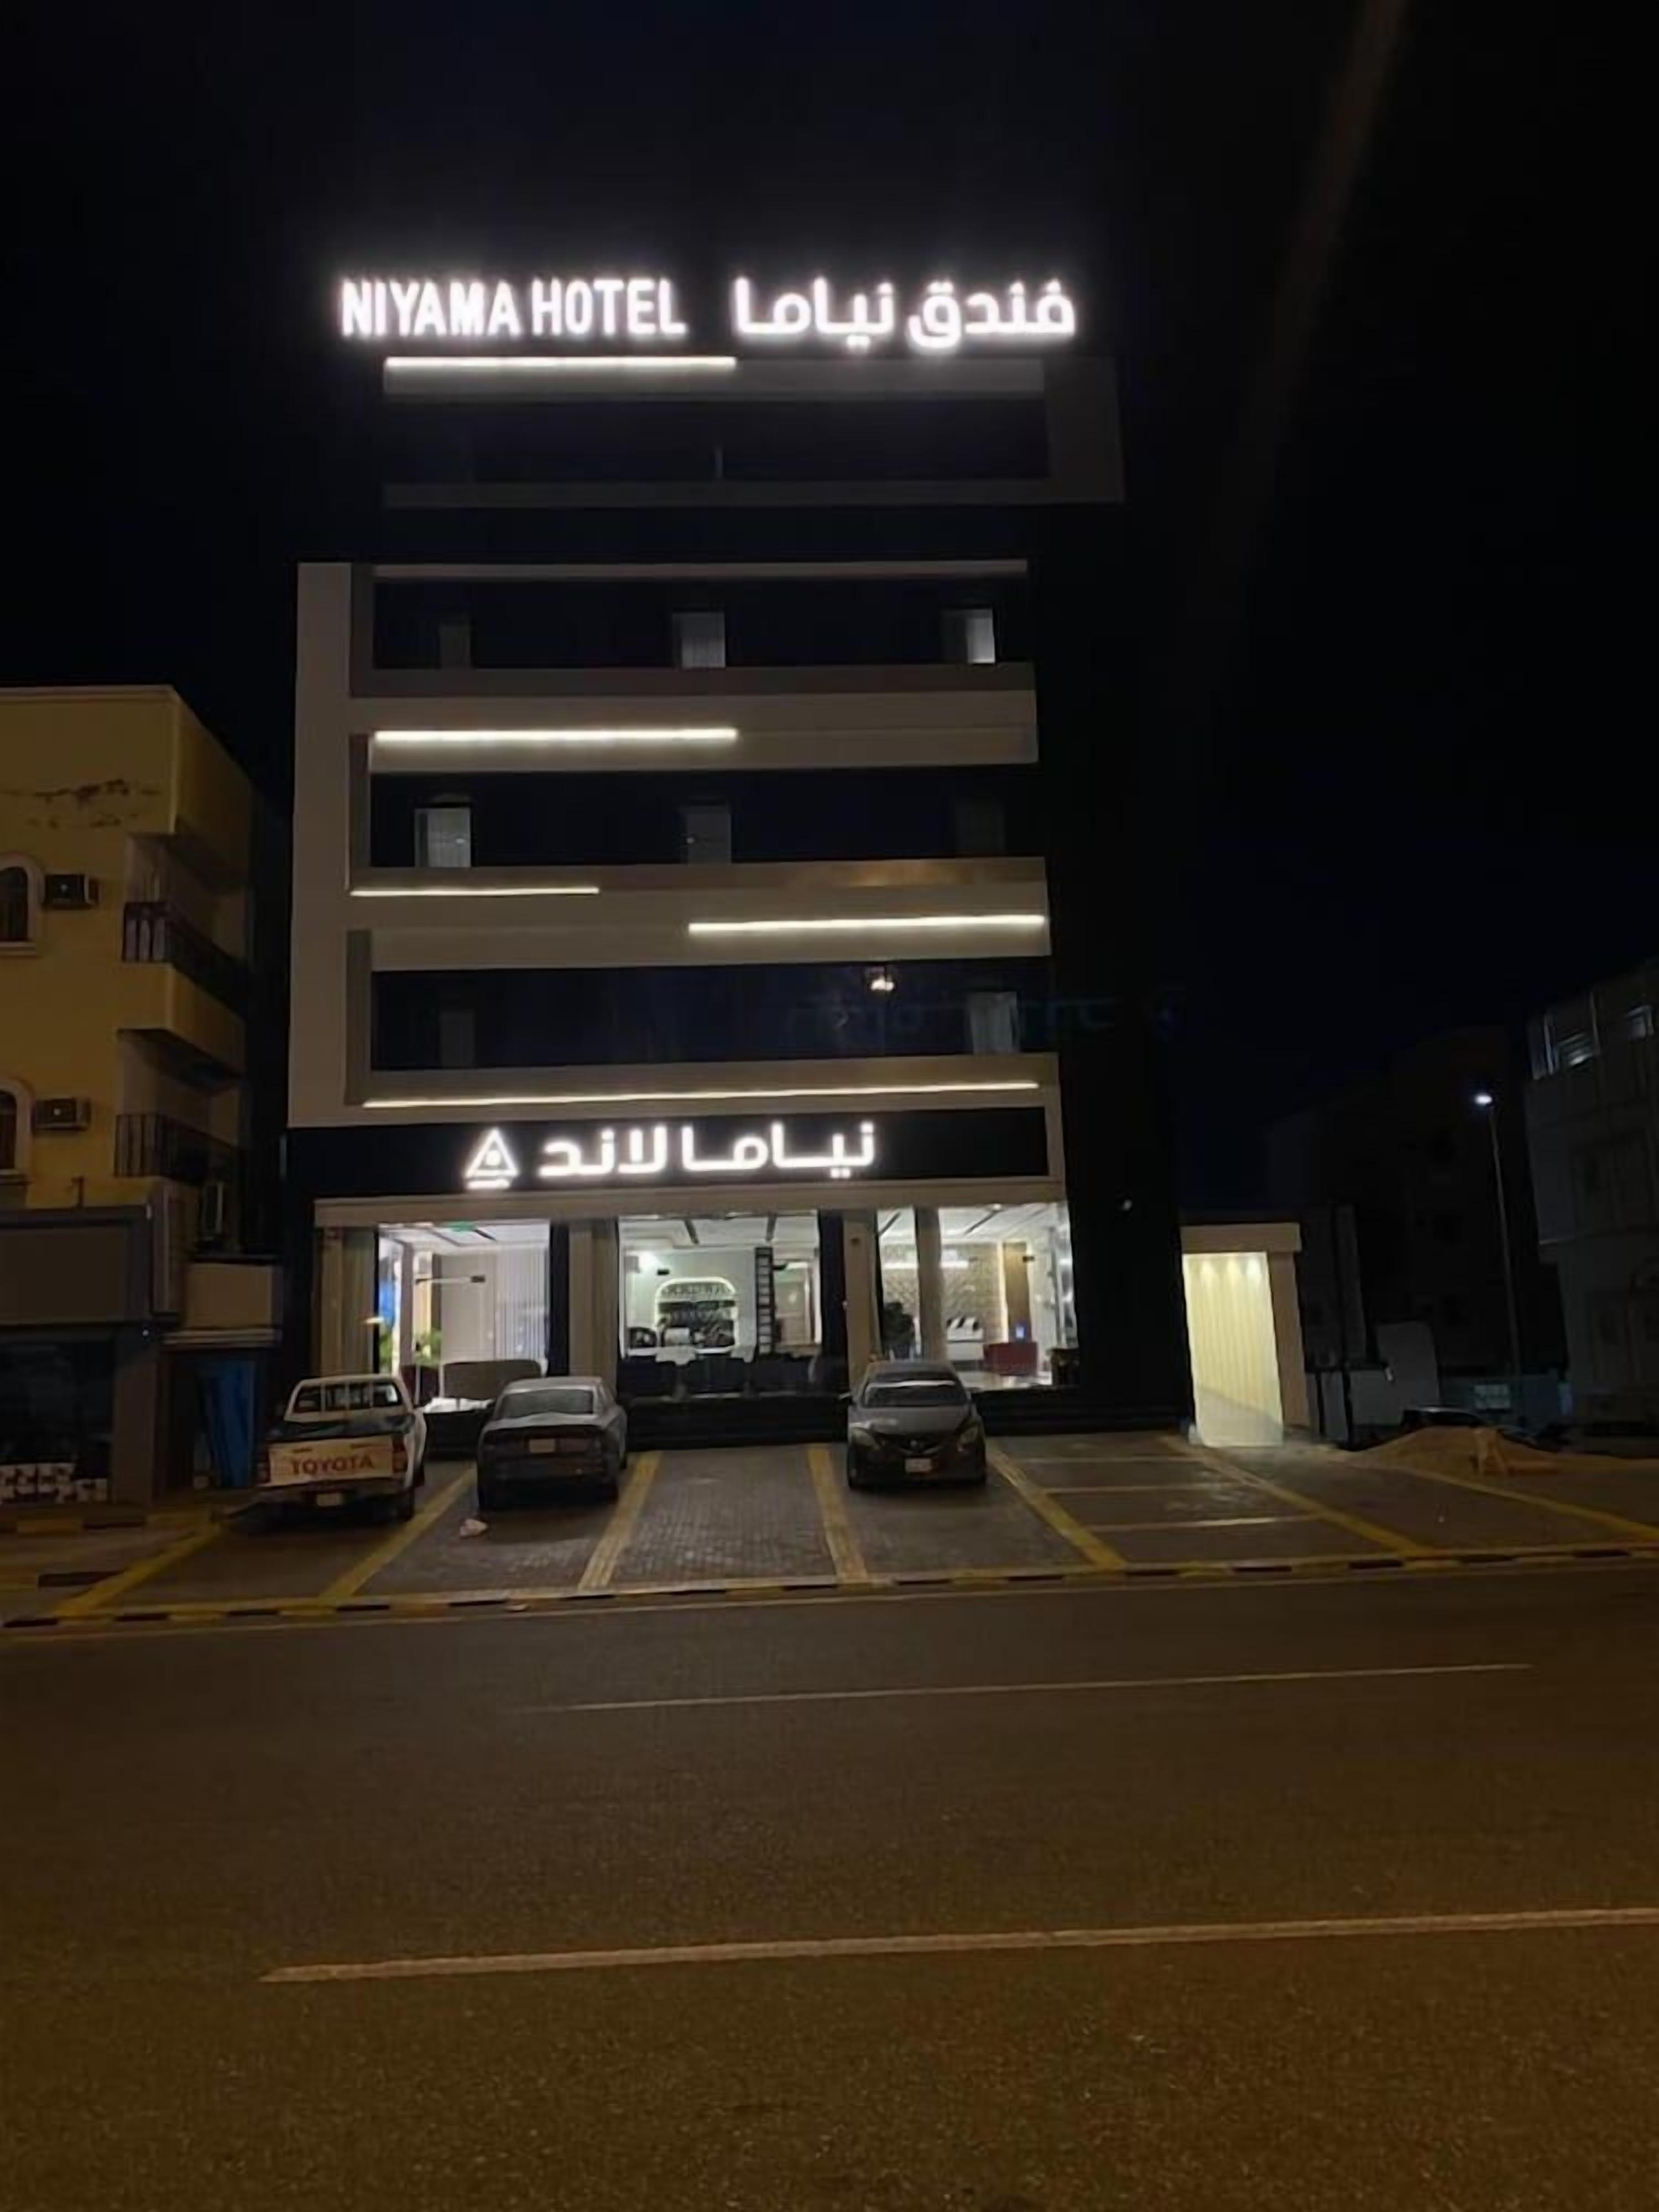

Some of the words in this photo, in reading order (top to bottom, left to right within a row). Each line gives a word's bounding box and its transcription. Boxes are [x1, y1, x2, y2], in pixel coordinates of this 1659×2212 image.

[342, 281, 521, 336] NIYAMA
[531, 279, 686, 336] HOTEL
[735, 278, 895, 349] نياما
[907, 279, 1075, 351] فندق
[539, 1125, 668, 1176] لاند
[681, 1123, 875, 1178] نياما
[290, 1454, 375, 1475] TOYOTA
